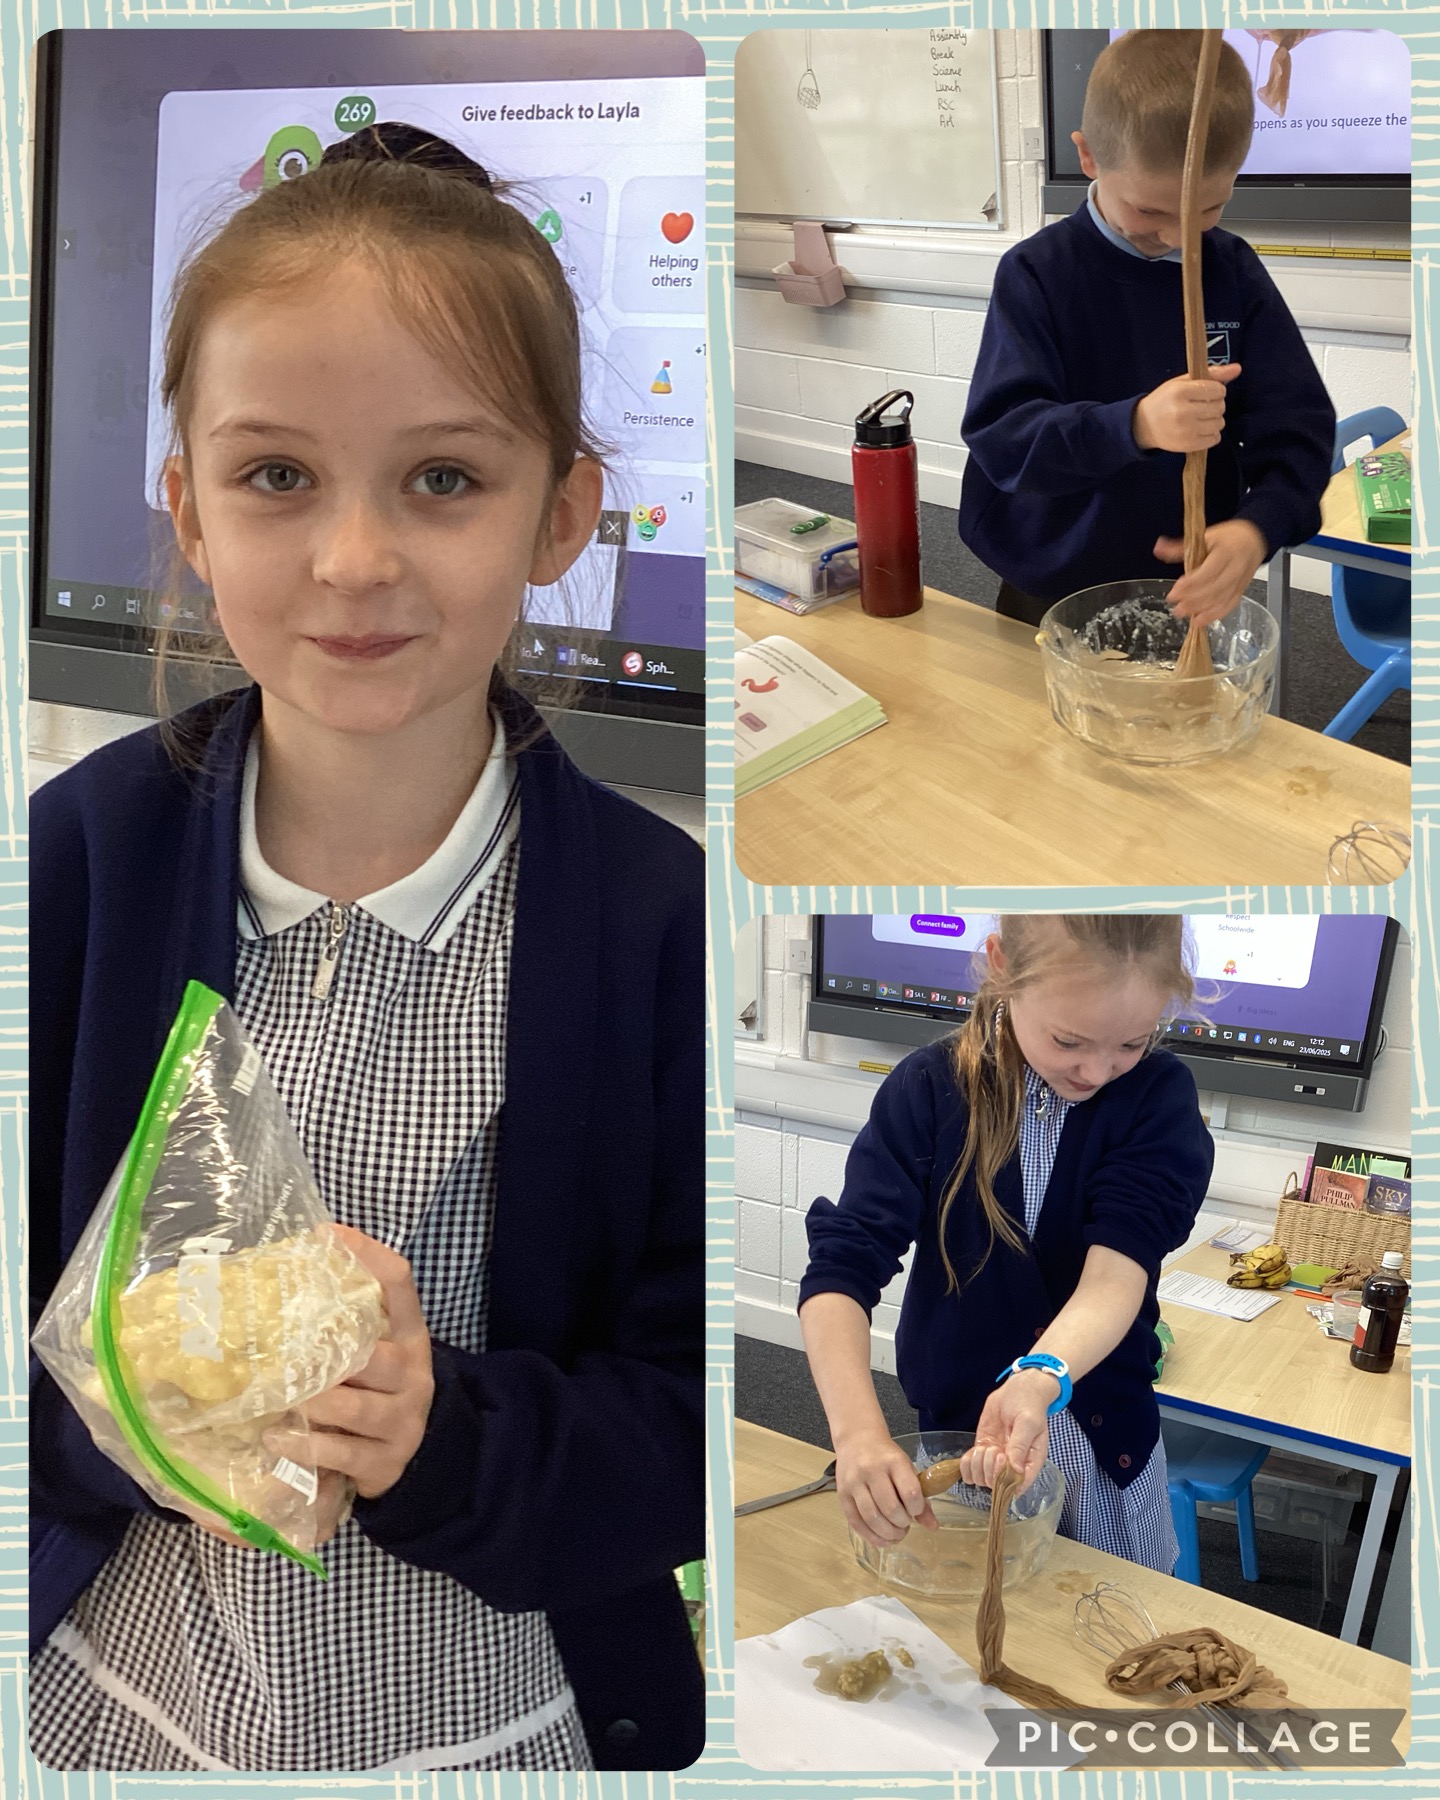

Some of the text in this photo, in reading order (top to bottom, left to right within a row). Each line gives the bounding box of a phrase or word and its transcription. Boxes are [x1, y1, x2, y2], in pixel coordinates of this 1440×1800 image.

[930, 47, 955, 60] Break
[933, 63, 962, 76] Science
[935, 80, 961, 92] Lunch
[338, 102, 372, 123] 269
[461, 101, 641, 122] Give feedback to Layla
[1253, 112, 1408, 132] ppens as you squeeze the
[579, 191, 592, 205] +1
[649, 254, 699, 271] Helping
[651, 273, 693, 288] others
[1217, 321, 1241, 329] WOOD
[623, 411, 695, 428] Persistence
[680, 491, 694, 504] +1
[916, 919, 960, 931] Connect family
[1218, 923, 1255, 934] Schoolwide
[1282, 1039, 1295, 1047] ENG
[1310, 1038, 1325, 1046] 12:12
[1299, 1046, 1331, 1057] 23/06/2025
[1326, 1187, 1353, 1201] PHILIP
[1374, 1185, 1408, 1205] SKY
[1320, 1194, 1356, 1210] PULLMAN
